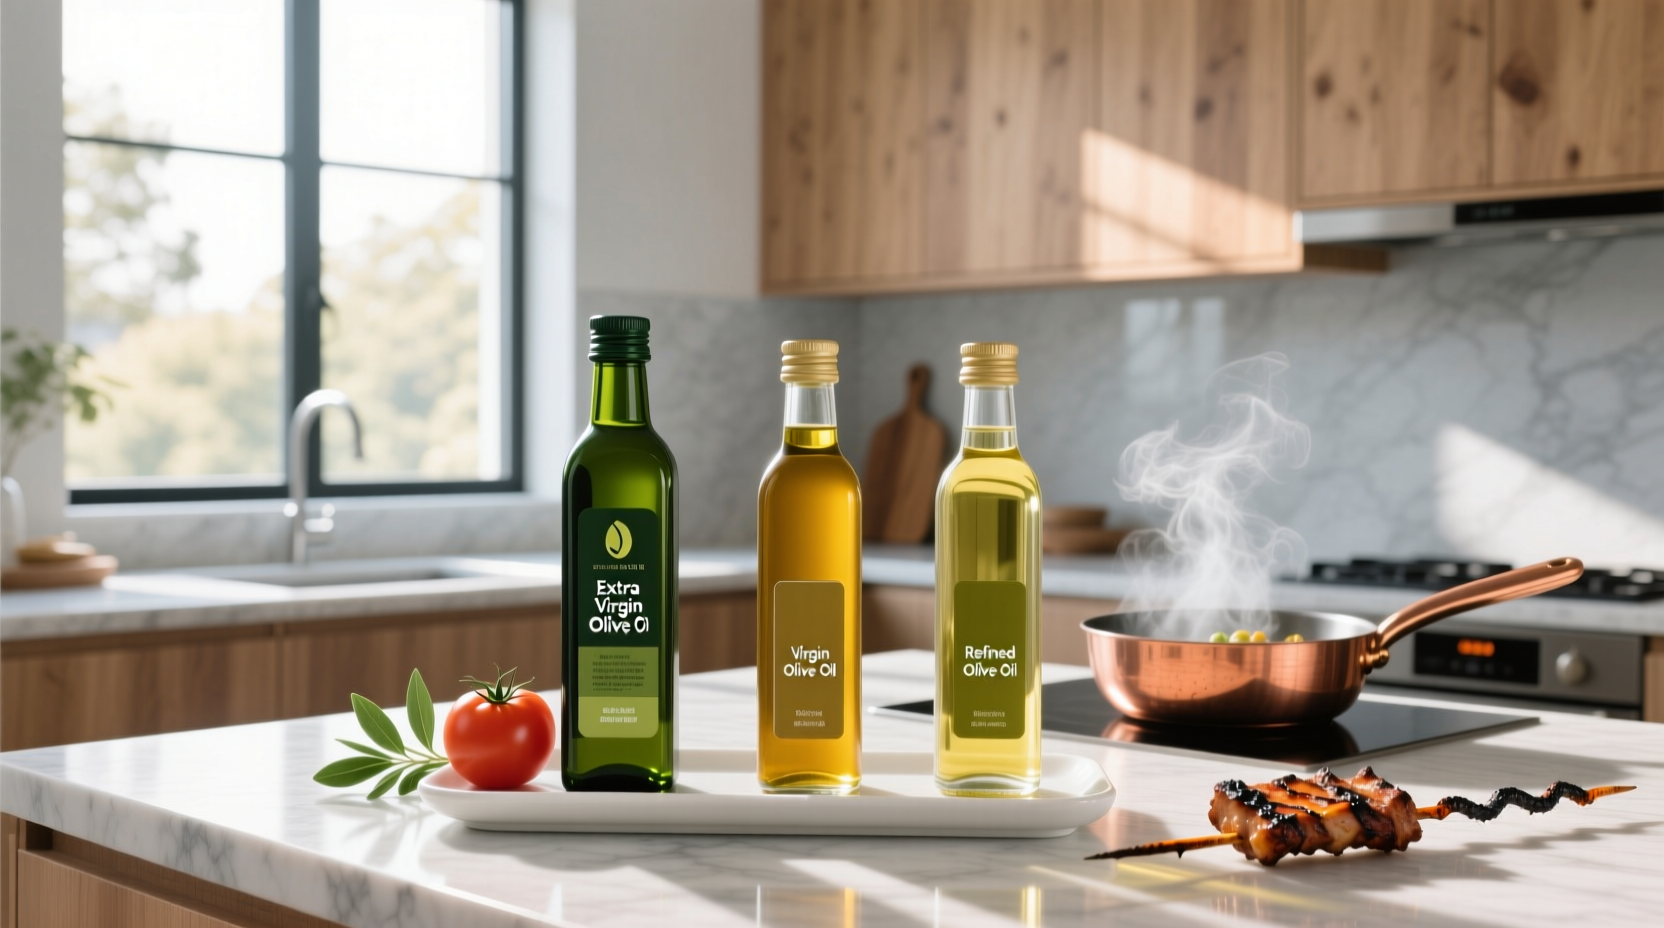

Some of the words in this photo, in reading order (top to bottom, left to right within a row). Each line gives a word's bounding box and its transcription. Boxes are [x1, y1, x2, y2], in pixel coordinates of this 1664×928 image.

[596, 579, 640, 596] Extra
[594, 596, 643, 619] Virgin
[589, 615, 632, 635] Olive
[790, 645, 830, 664] Virgin
[965, 644, 1016, 660] Refined
[783, 662, 817, 678] Olive
[819, 662, 837, 678] Oil
[963, 661, 998, 678] Olive
[999, 662, 1018, 678] Oil
